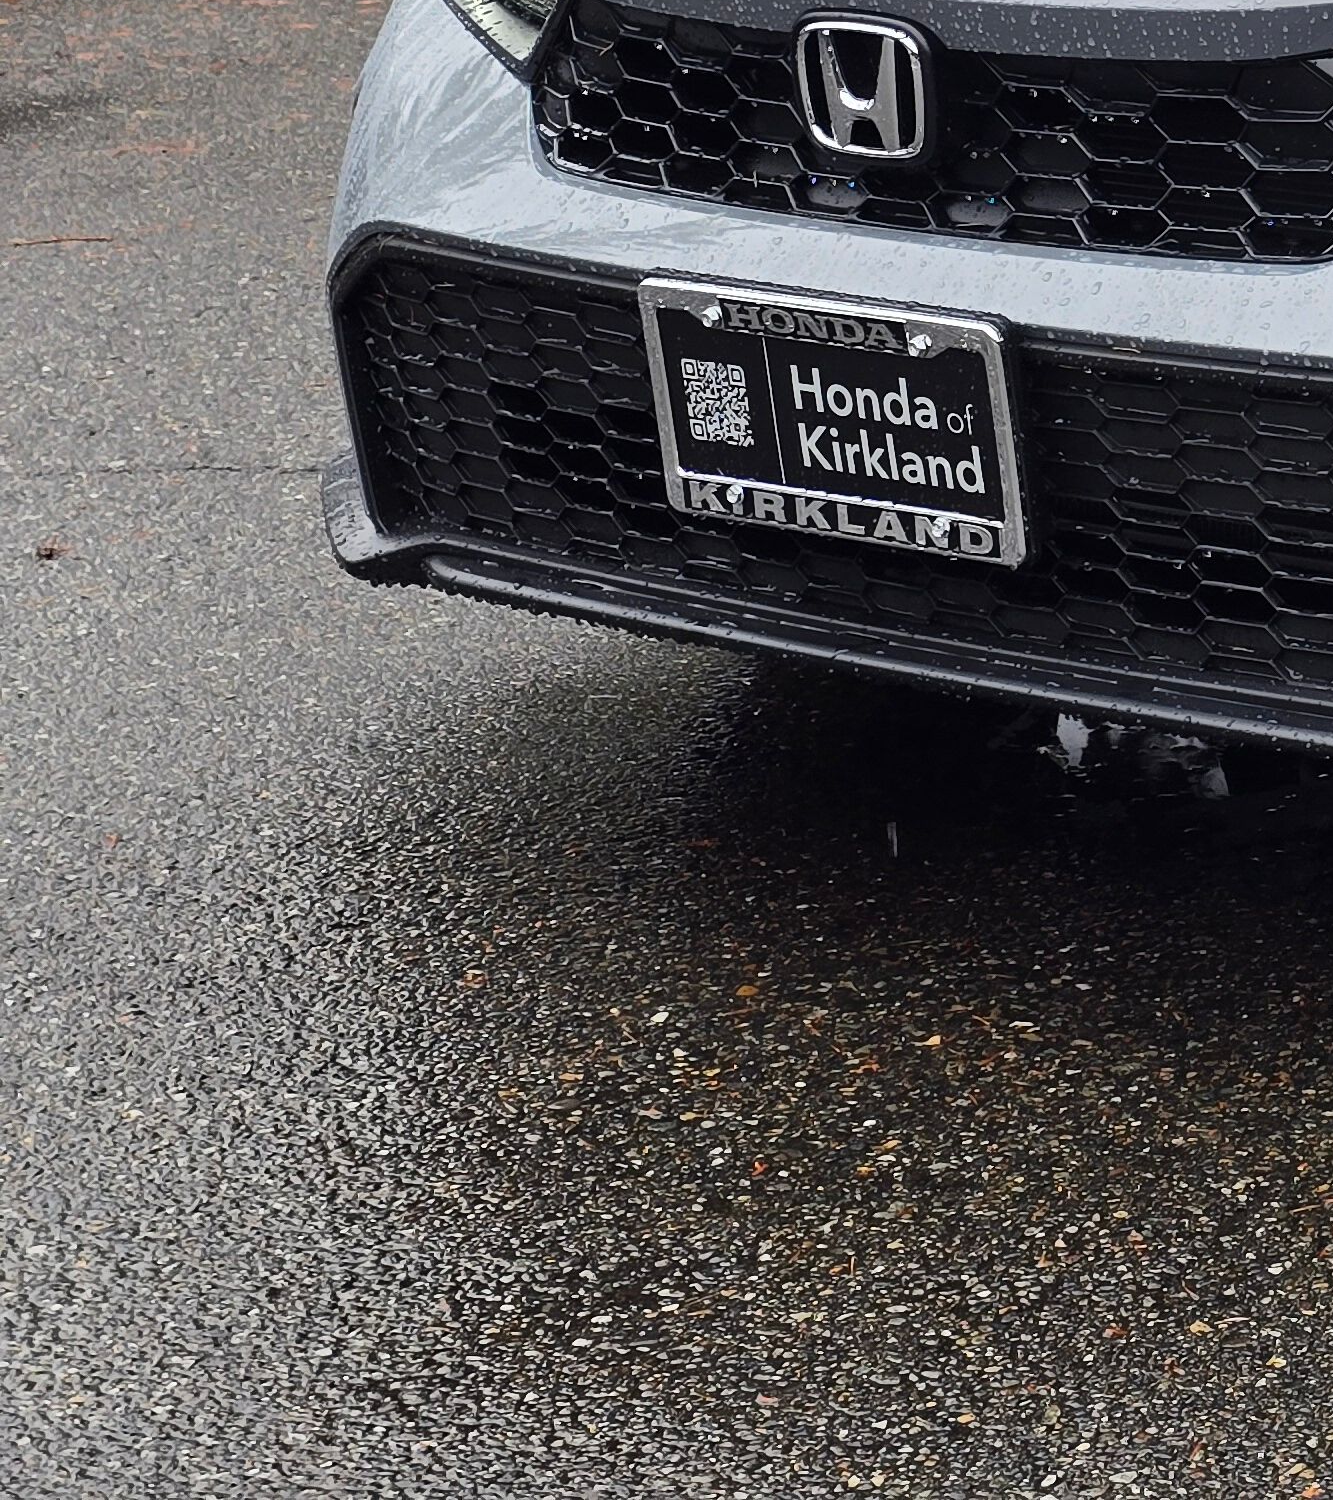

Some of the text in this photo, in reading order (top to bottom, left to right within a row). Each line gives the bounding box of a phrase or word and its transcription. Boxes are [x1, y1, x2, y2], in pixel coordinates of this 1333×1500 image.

[727, 303, 902, 349] HONDA
[789, 364, 975, 436] Honda of
[798, 422, 986, 495] Kirkland
